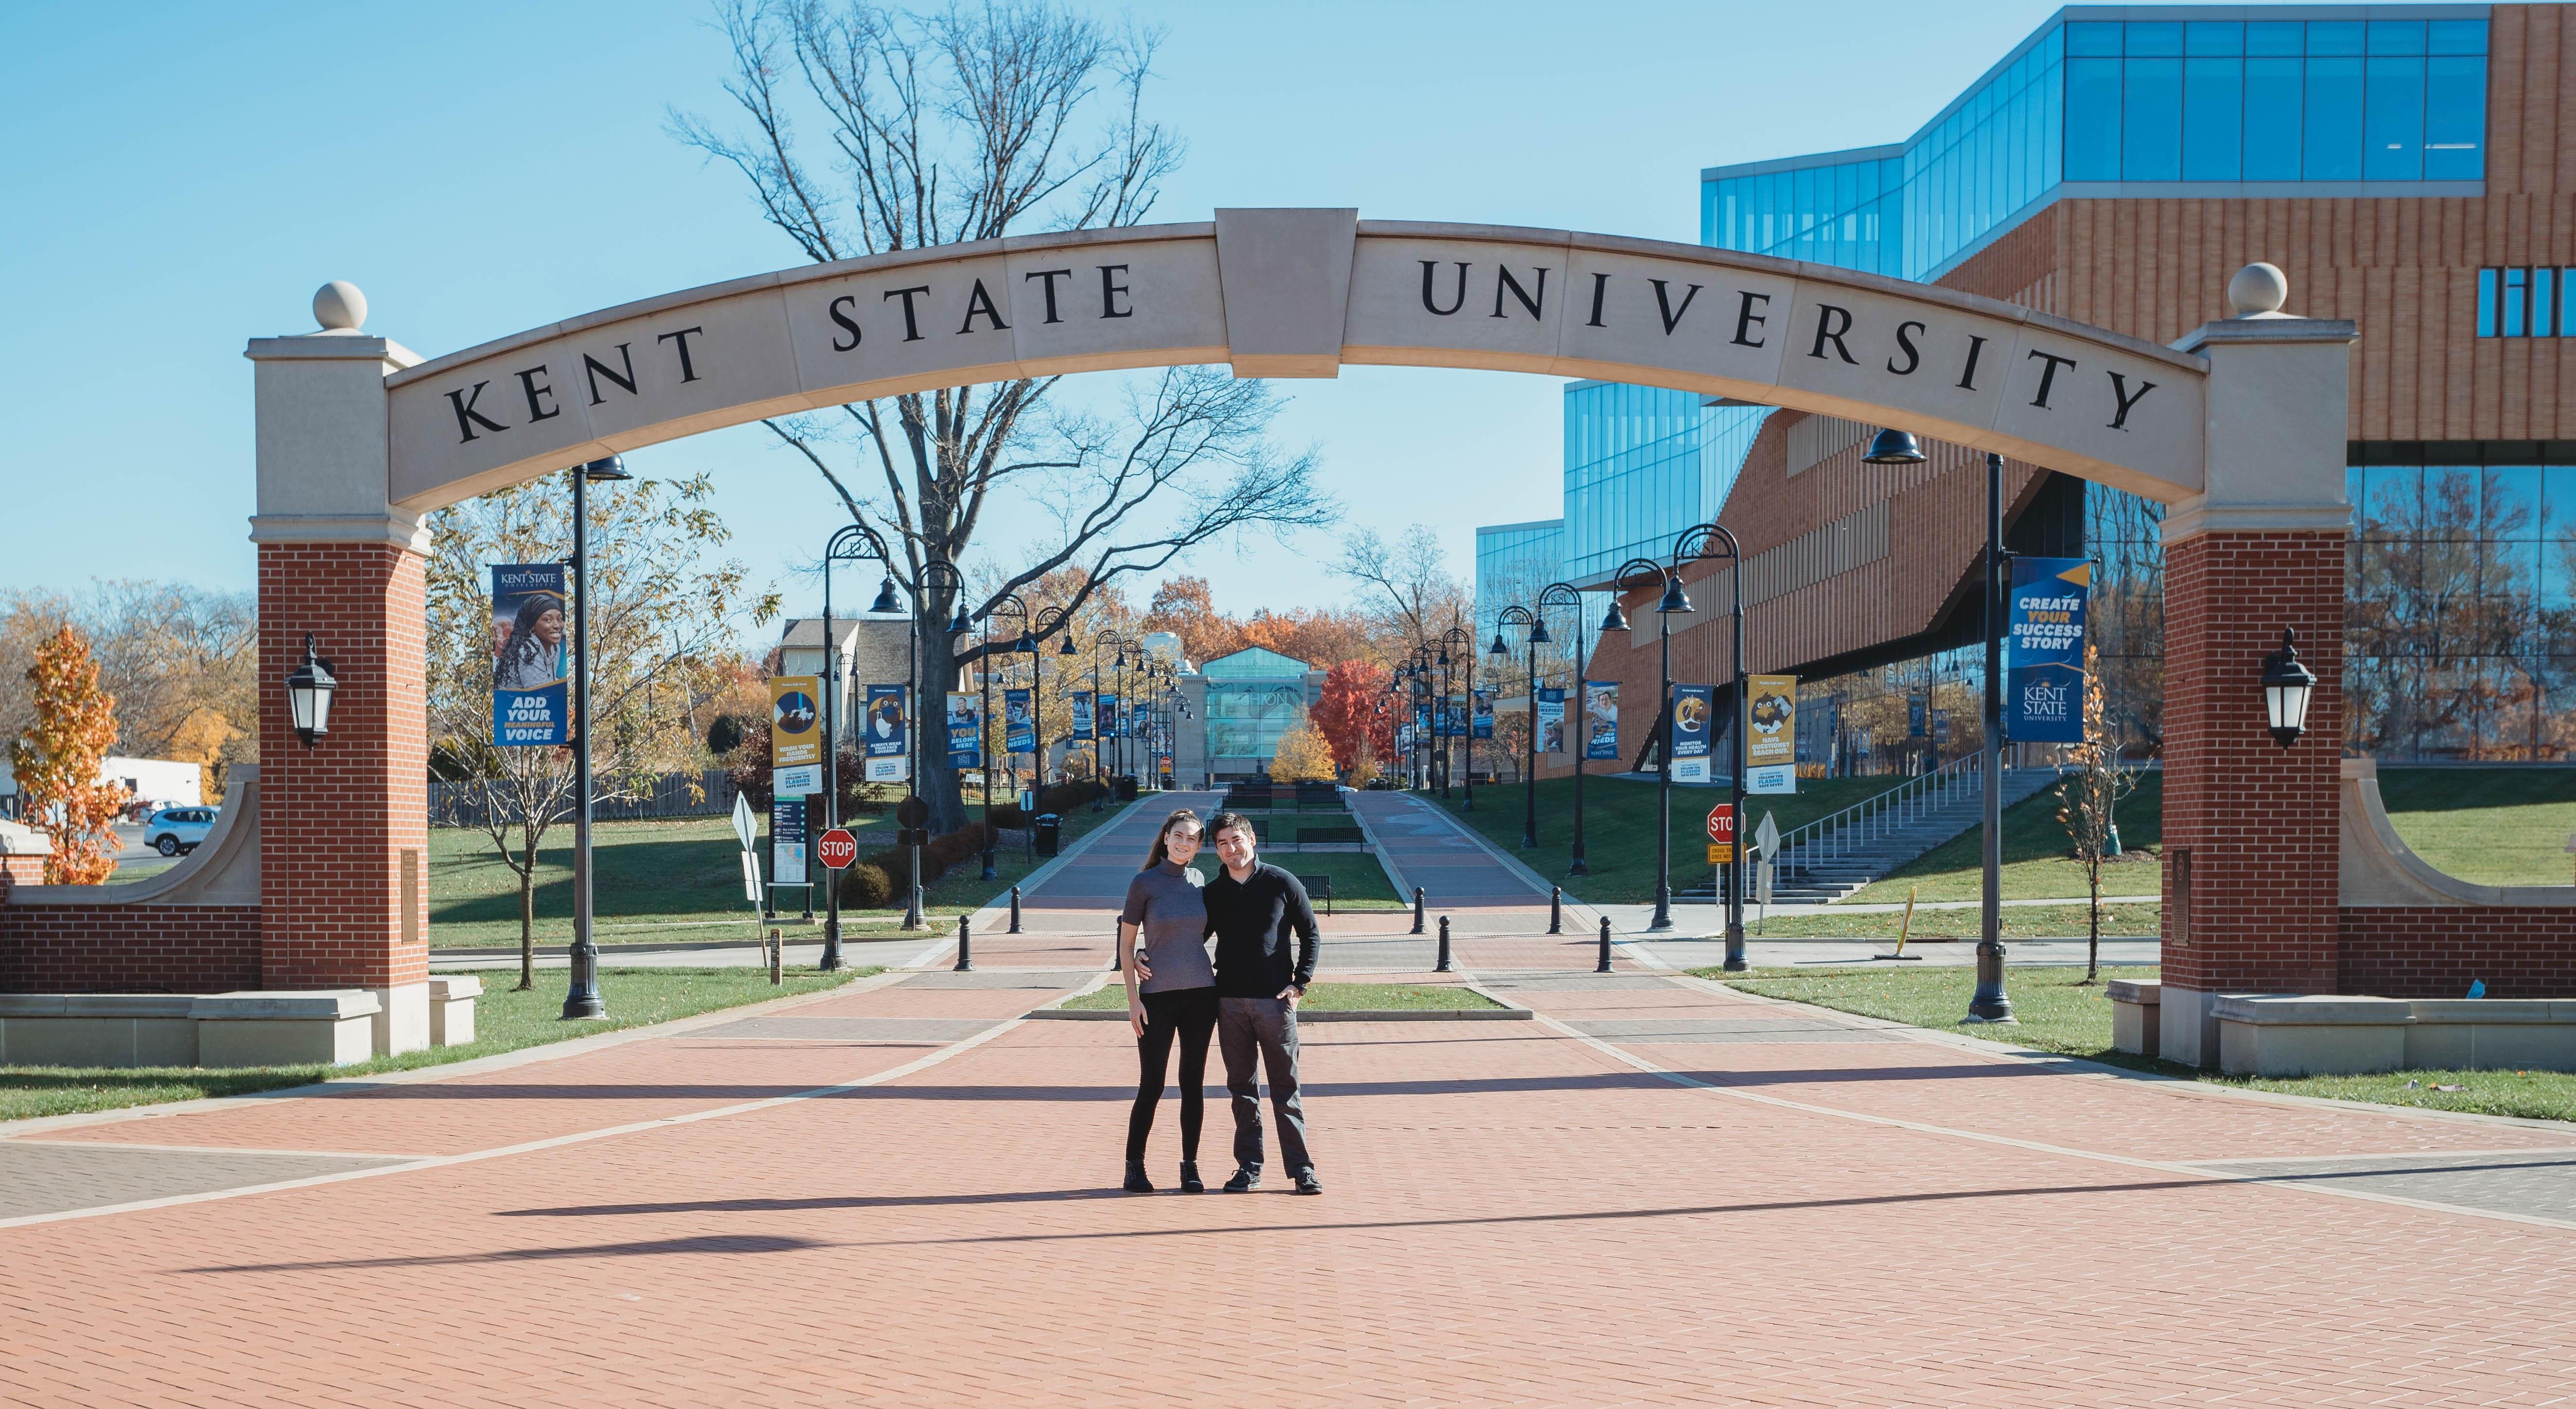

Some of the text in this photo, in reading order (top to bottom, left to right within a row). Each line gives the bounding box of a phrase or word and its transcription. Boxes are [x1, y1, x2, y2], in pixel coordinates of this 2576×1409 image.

[443, 260, 2159, 444] KENT STATE UNIVERSITY
[1690, 541, 1721, 556] KSU
[502, 573, 557, 583] KENT STATE
[2019, 597, 2080, 611] CREATE
[2028, 611, 2070, 623] YOUR
[2013, 623, 2083, 637] SUCCESS
[2021, 636, 2074, 650] STORY
[2024, 687, 2067, 701] KENT
[511, 697, 547, 708] ADD
[2024, 701, 2067, 715] STATE
[507, 709, 550, 721] YOUR
[506, 728, 553, 740] VOICE
[950, 727, 976, 738] YOU
[1008, 738, 1031, 748] NEEDS
[779, 754, 815, 762] FREQUENTLY
[1711, 816, 1733, 831] STO
[821, 841, 854, 857] STOP
